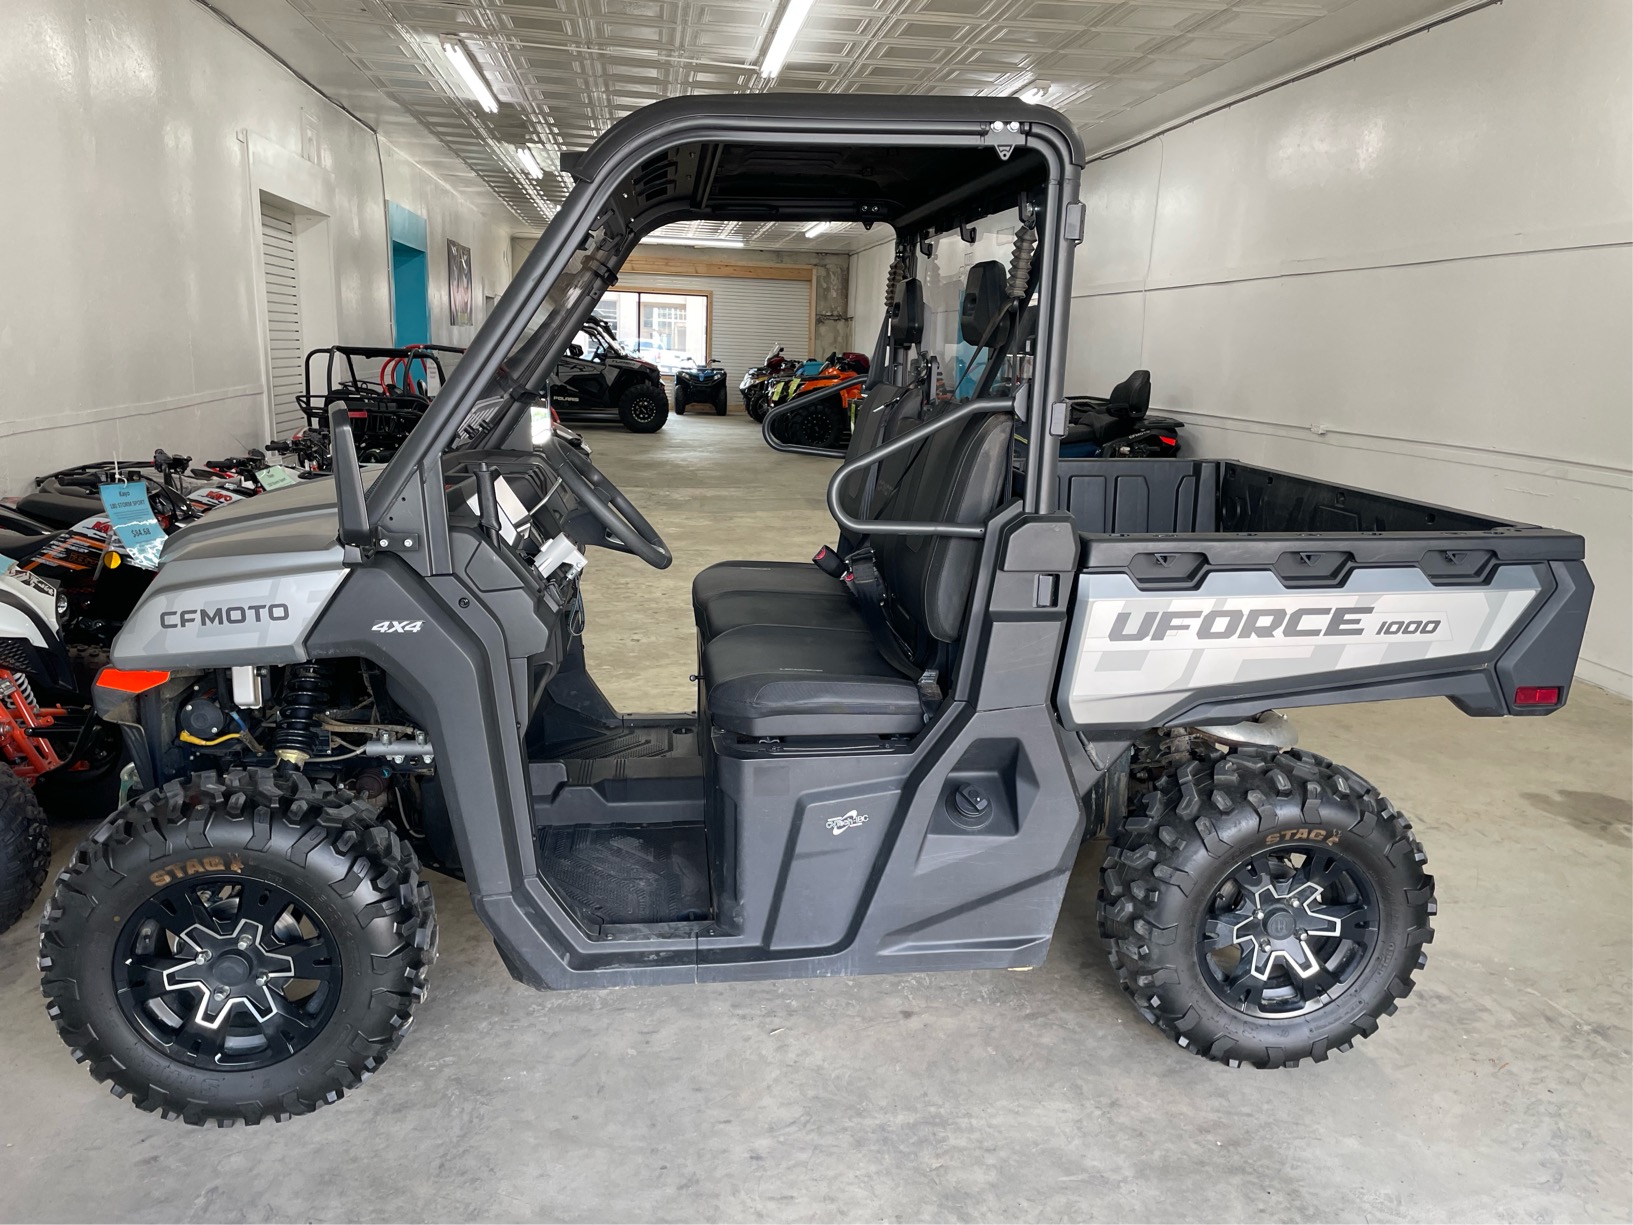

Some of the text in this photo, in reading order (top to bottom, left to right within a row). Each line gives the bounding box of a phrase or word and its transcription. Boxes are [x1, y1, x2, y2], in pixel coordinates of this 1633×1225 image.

[160, 603, 290, 629] CFMOTO
[1107, 606, 1442, 642] UFORCE 1000
[149, 855, 226, 887] STAG
